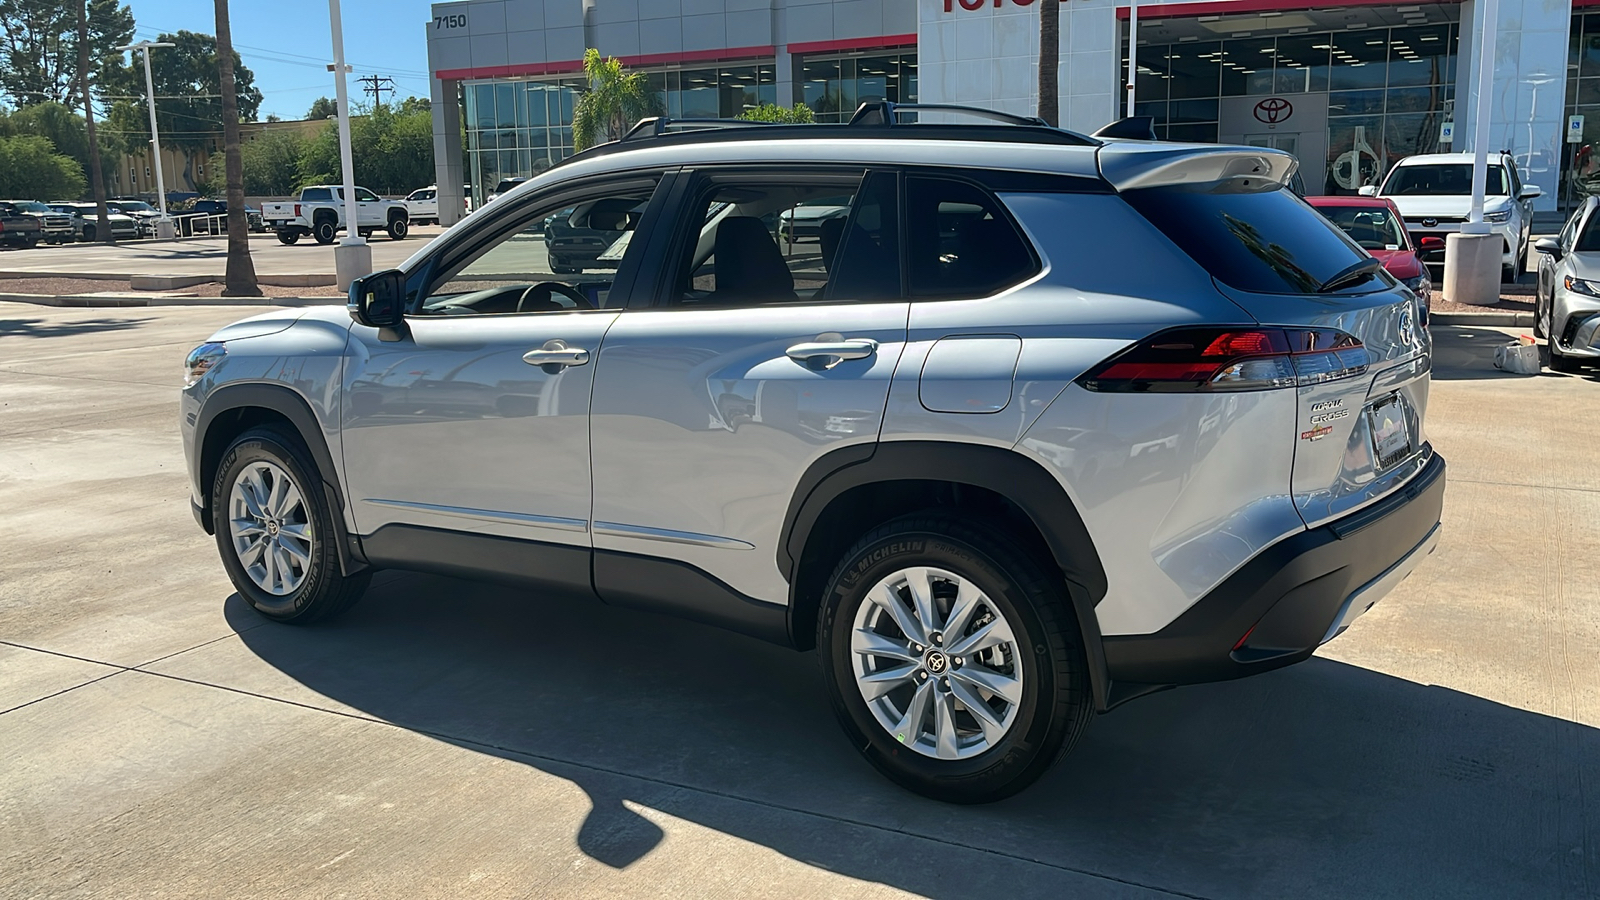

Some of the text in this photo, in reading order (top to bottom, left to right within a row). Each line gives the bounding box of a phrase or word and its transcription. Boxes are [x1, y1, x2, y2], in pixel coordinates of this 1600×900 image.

[435, 14, 466, 29] 7150
[1311, 399, 1343, 411] COROLLA
[1310, 408, 1349, 424] CROSS
[215, 451, 236, 493] MICHELIN
[858, 540, 924, 572] MICHELIN
